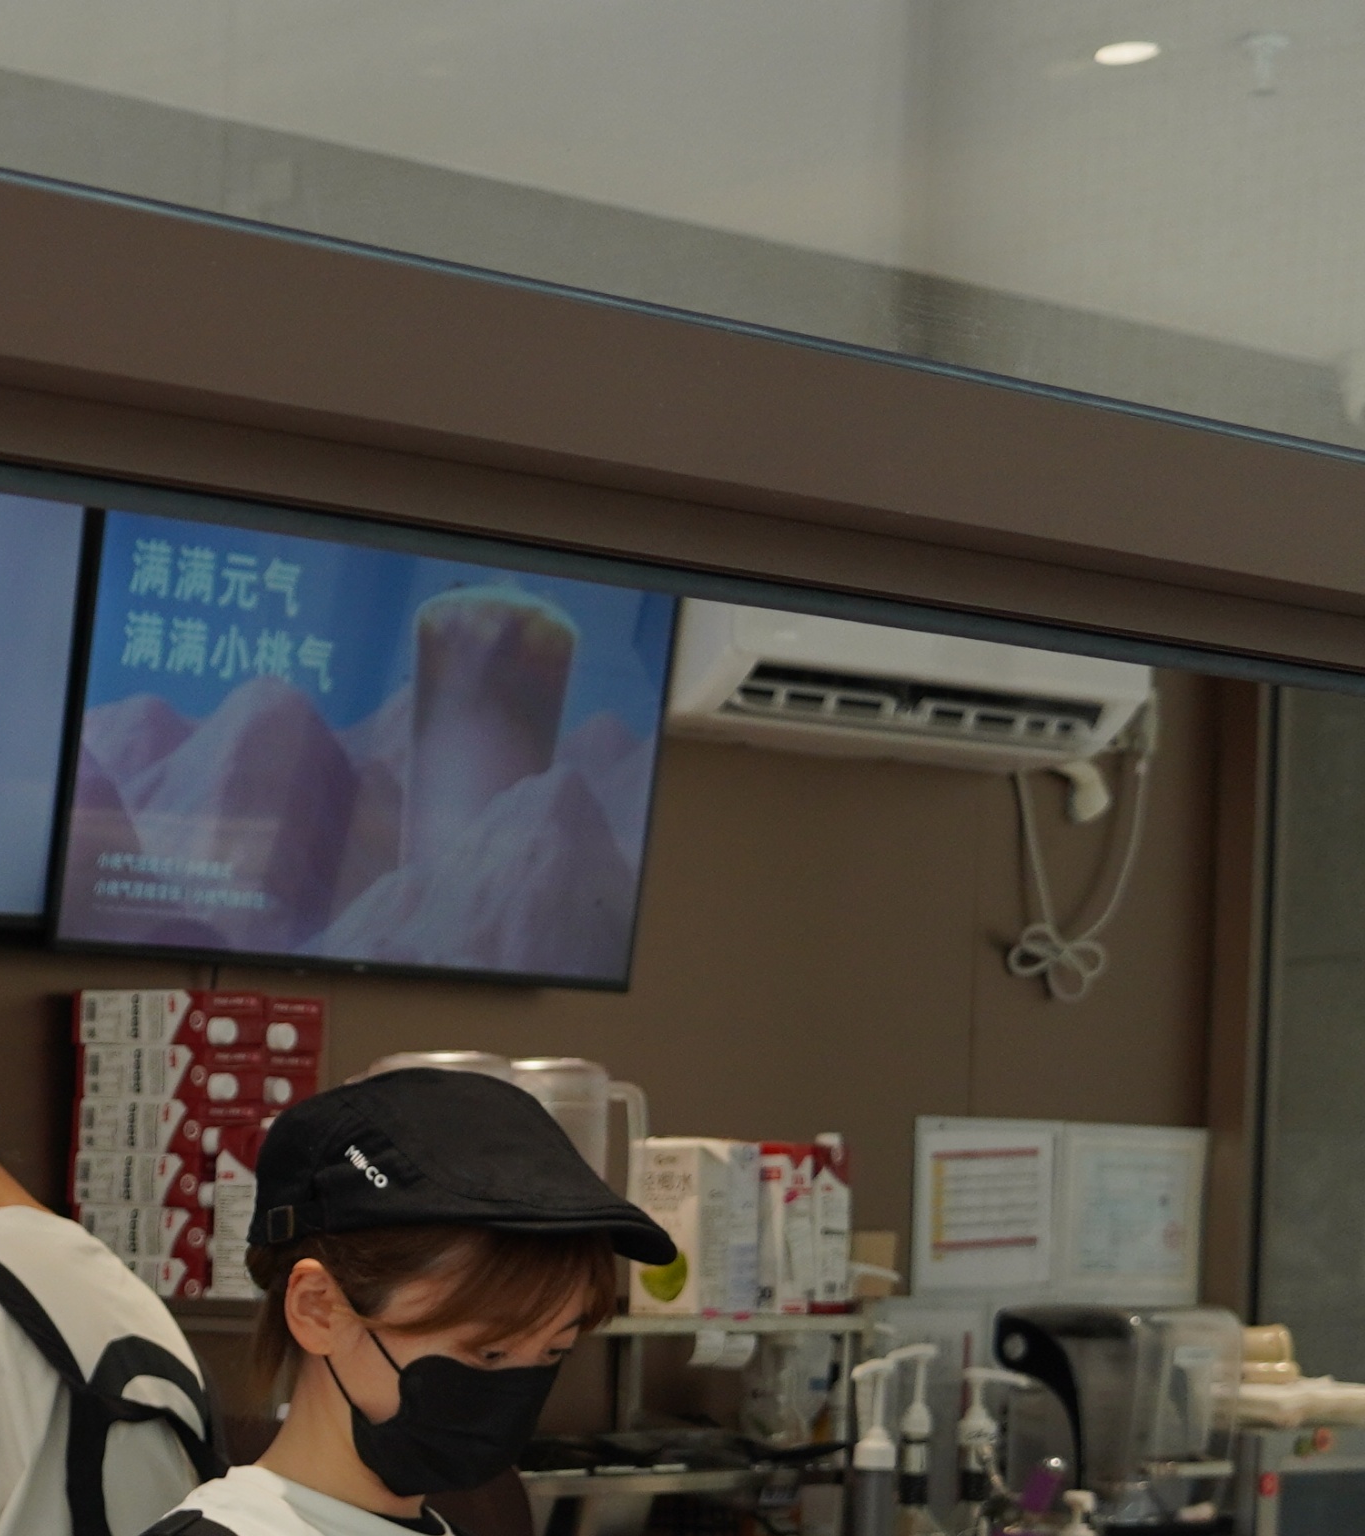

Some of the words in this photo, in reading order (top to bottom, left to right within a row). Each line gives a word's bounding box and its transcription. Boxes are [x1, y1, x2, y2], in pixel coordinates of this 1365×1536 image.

[129, 538, 301, 617] 满满元气
[121, 610, 333, 693] 满满小桃气
